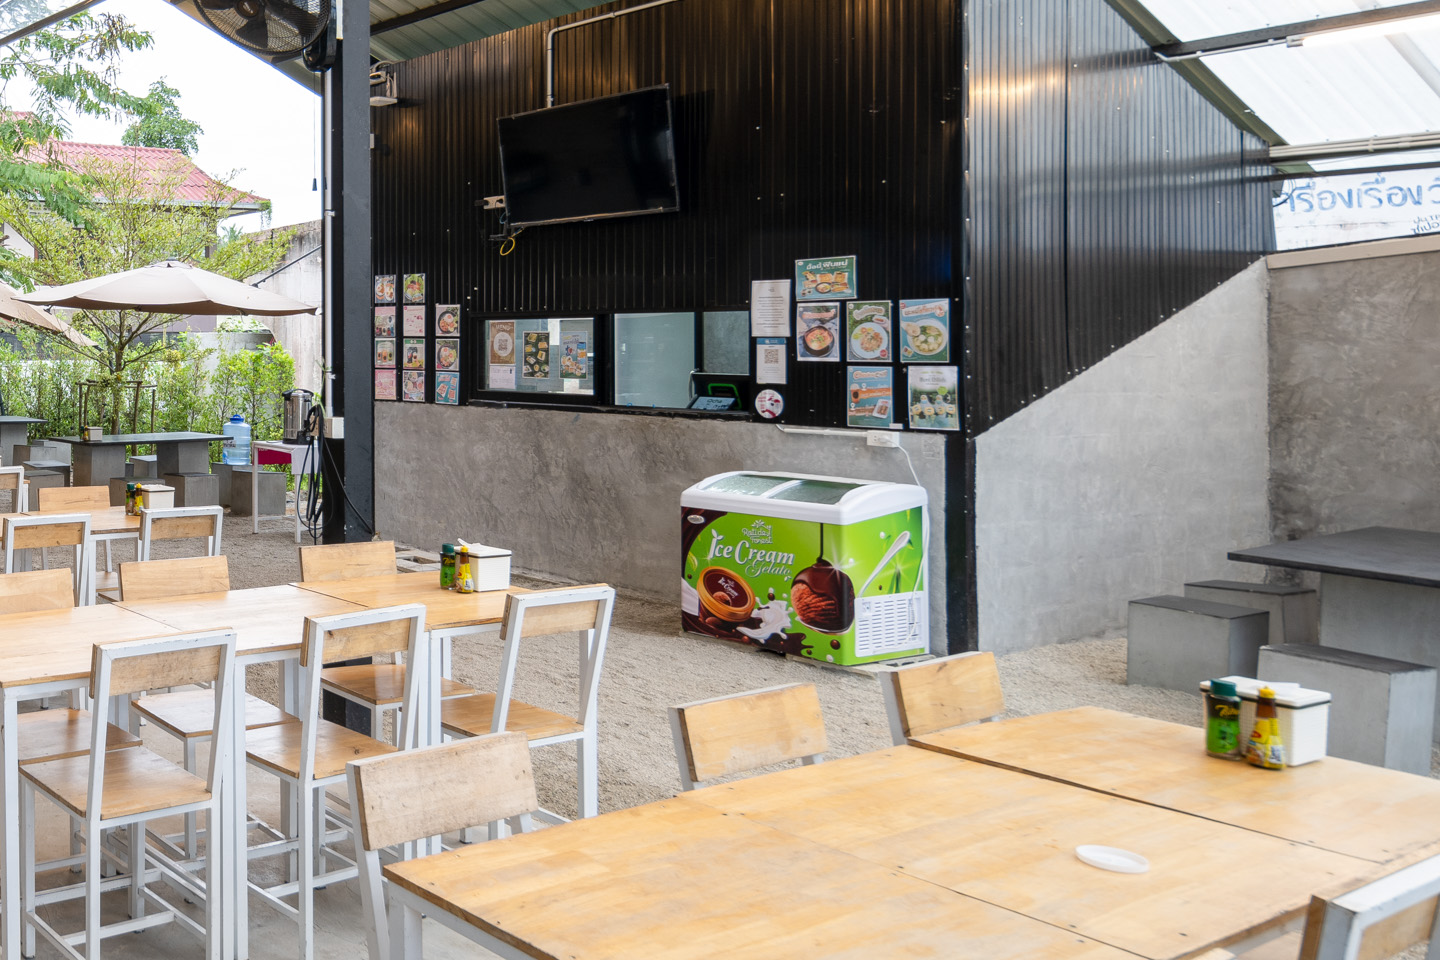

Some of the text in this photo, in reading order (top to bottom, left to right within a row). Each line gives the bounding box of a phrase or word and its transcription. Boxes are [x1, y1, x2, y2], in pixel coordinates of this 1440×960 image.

[709, 535, 795, 565] Ice Cream
[745, 559, 792, 578] Gelato
